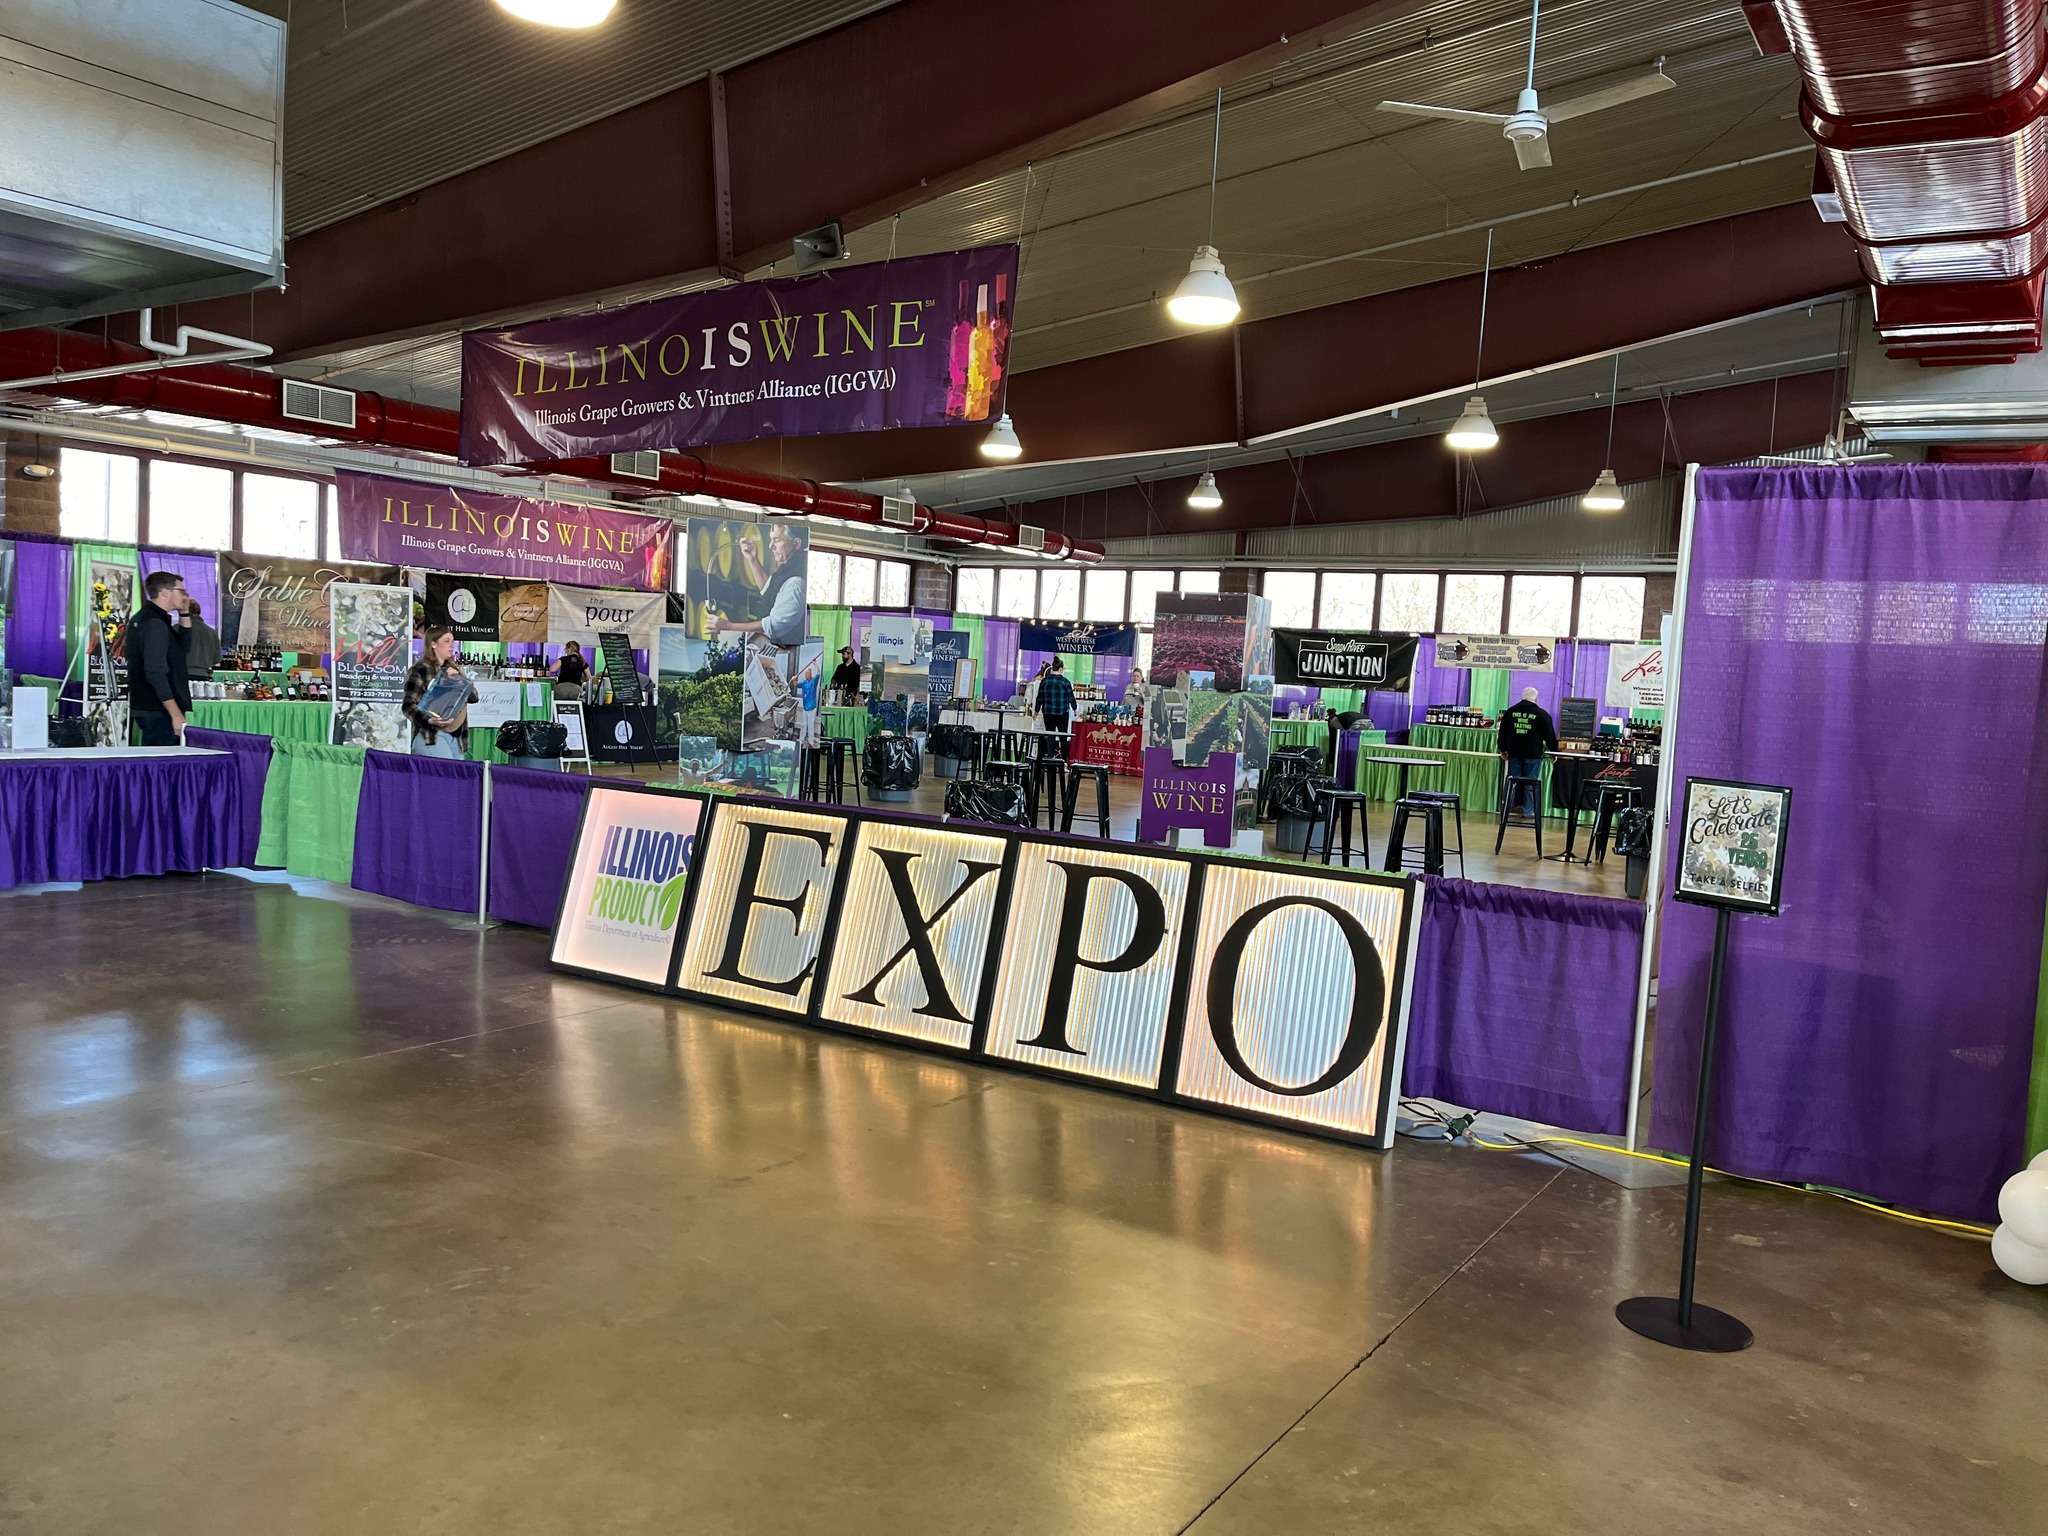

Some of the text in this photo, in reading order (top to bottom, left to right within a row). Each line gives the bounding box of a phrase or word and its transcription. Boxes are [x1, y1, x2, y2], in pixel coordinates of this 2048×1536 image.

[535, 367, 896, 427] Illinois Grape Growers & Vintners Alliance (IGGVA)
[401, 534, 624, 572] Illinois Grape Growers & Vintners Alliance (IGGVA)
[229, 566, 312, 606] Sable
[585, 606, 634, 627] pour
[1057, 643, 1095, 652] WINERY
[337, 662, 407, 674] BLOSSOM
[1302, 653, 1382, 677] JUNCTION
[340, 673, 370, 682] meadery
[380, 675, 404, 684] winery
[1153, 778, 1226, 794] ILLINOIS
[1152, 791, 1225, 814] WINE
[1707, 796, 1752, 820] Let's
[1690, 808, 1773, 844] Celebrate
[598, 825, 695, 884] ILLINOIS
[1691, 873, 1716, 885] TAKE
[1718, 877, 1726, 886] A
[588, 875, 661, 927] PRODUCT
[701, 821, 1386, 1096] EXPO
